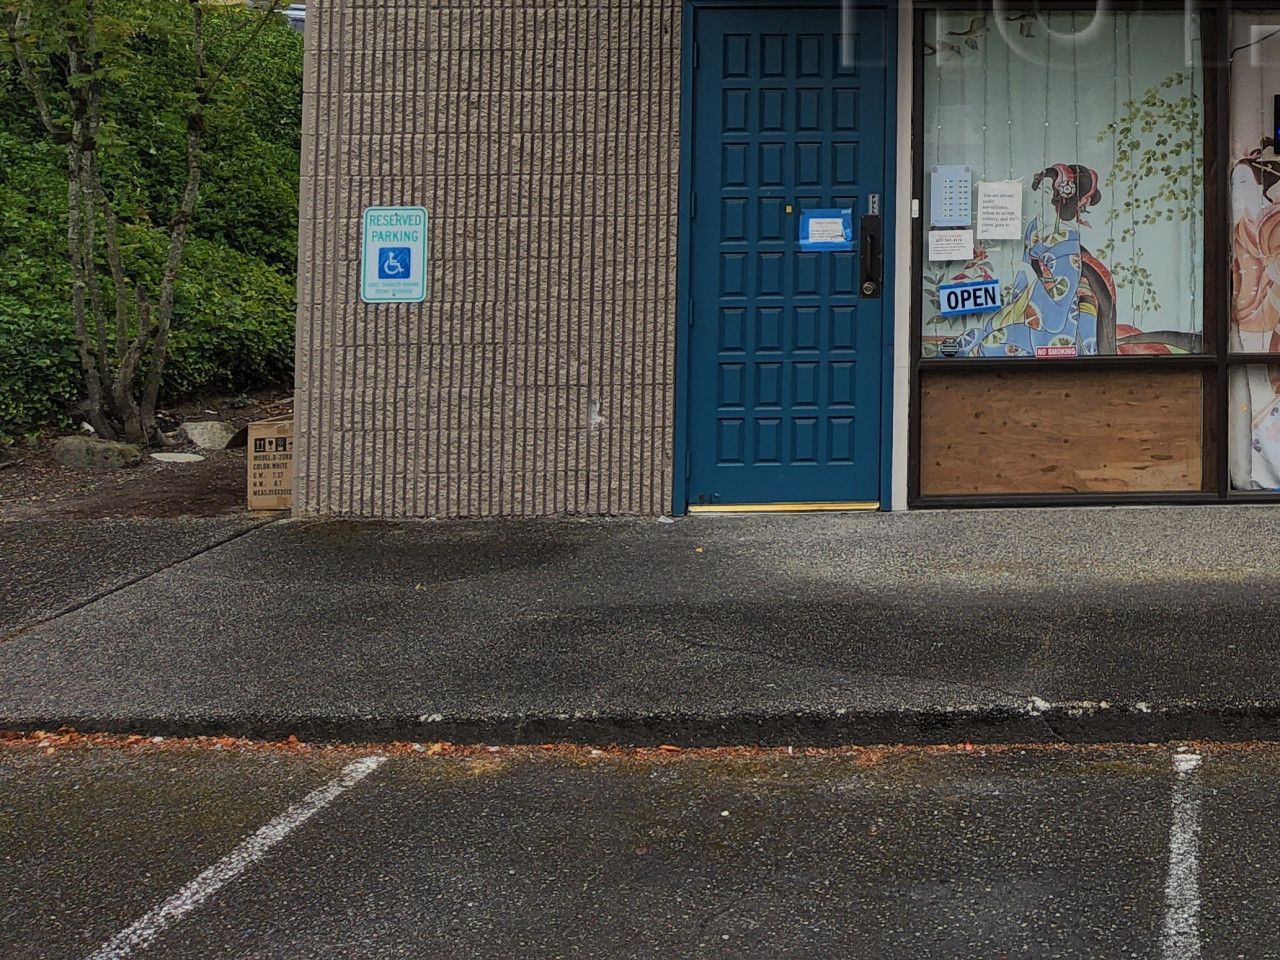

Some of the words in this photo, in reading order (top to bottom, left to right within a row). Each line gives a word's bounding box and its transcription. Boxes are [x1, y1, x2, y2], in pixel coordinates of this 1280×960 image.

[369, 214, 421, 227] RESERVED
[371, 230, 419, 242] PARKING
[946, 286, 997, 310] OPEN
[1037, 347, 1047, 356] NO
[1048, 347, 1076, 356] SMOKING
